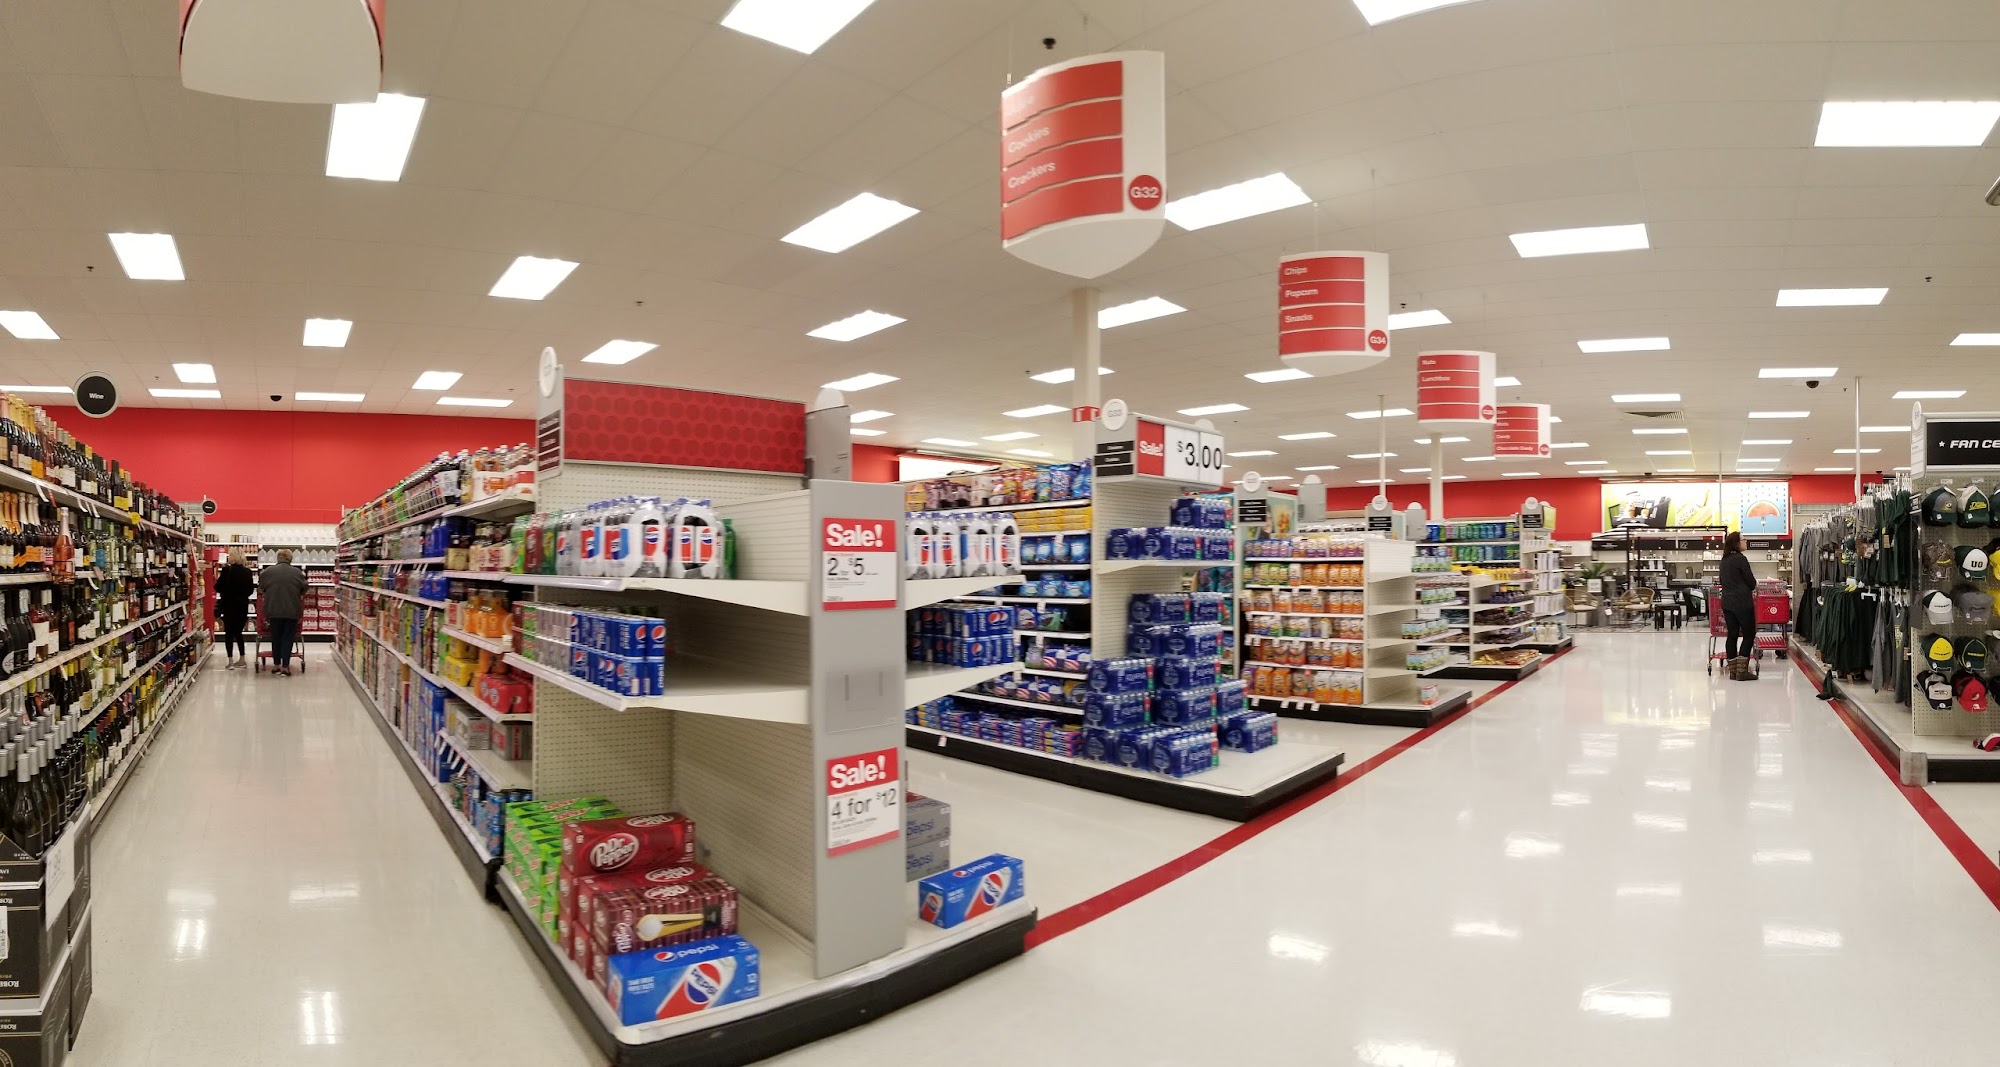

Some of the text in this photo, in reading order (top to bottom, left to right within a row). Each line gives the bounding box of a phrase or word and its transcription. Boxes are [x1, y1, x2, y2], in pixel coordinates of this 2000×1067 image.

[1007, 162, 1056, 188] Crackers
[1130, 186, 1160, 199] G32
[1284, 266, 1308, 276] Chips
[1284, 288, 1319, 298] Popcorn
[1284, 313, 1314, 323] Snacks
[1369, 335, 1387, 345] G34
[88, 392, 105, 400] Wine
[1139, 440, 1164, 457] Sale!
[1949, 439, 1980, 449] FAN
[825, 522, 884, 548] Sale!
[827, 557, 840, 576] 2
[848, 557, 865, 576] $5
[830, 755, 887, 789] Sale!
[831, 787, 897, 820] 4 for $12
[677, 943, 720, 958] pepsi
[691, 967, 719, 995] PEPSI
